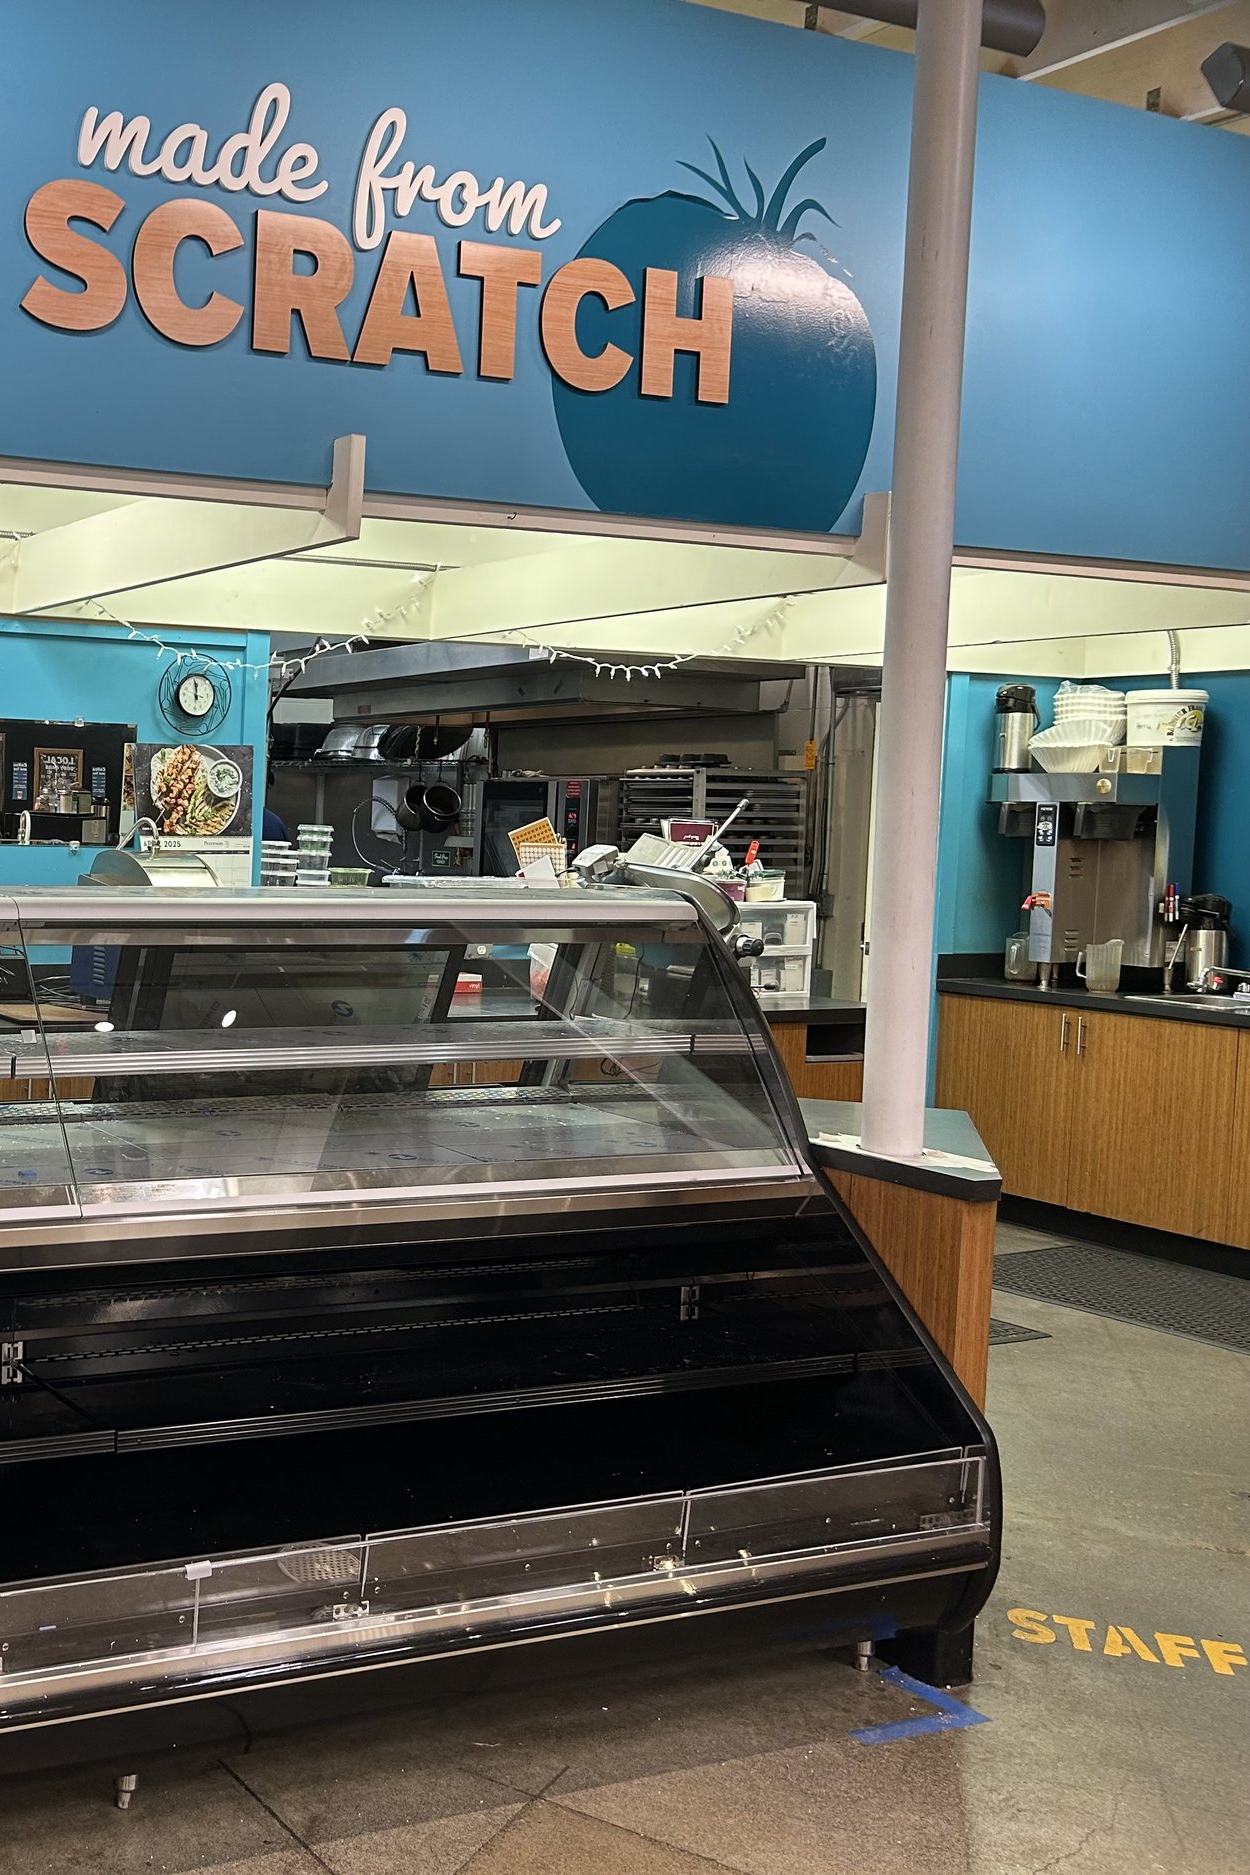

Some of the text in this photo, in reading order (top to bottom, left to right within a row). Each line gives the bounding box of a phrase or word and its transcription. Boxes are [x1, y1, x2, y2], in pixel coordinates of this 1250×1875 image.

[78, 82, 561, 251] made from
[20, 178, 735, 405] SCRATCH
[1006, 1607, 1249, 1676] STAFF
